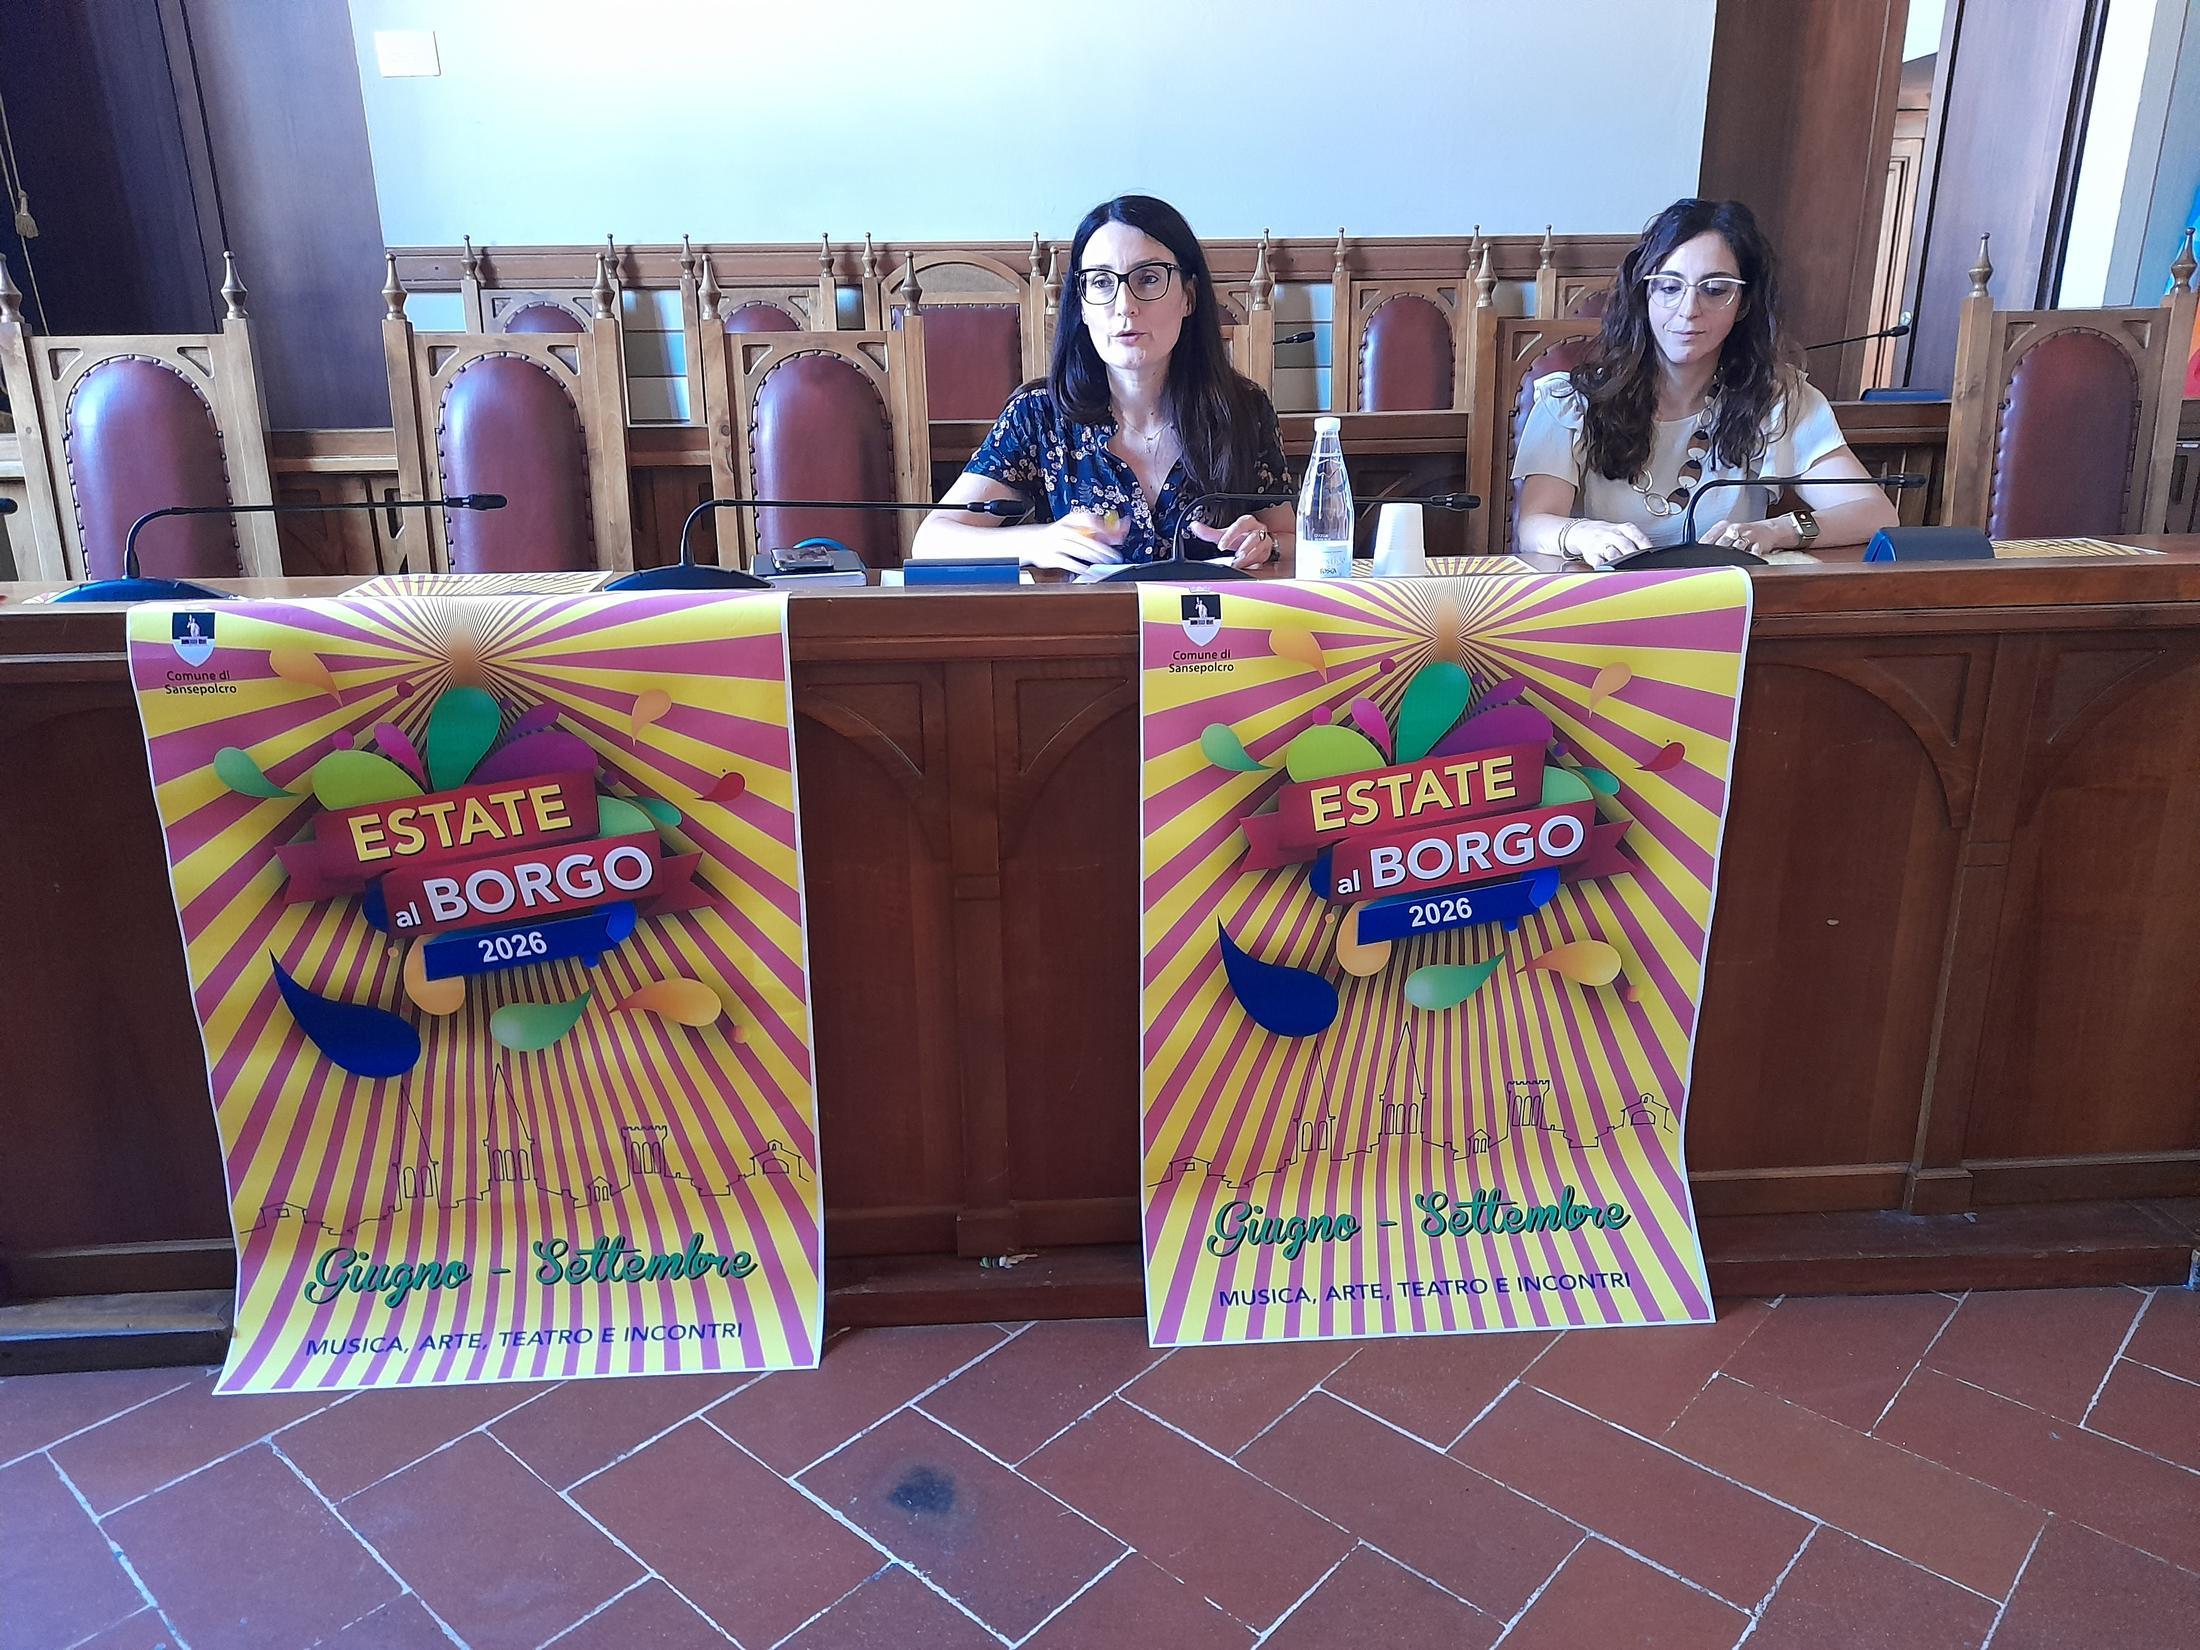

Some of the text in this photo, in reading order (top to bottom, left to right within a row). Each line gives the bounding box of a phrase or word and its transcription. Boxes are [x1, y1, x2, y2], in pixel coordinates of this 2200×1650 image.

[1168, 662, 1234, 674] Sansepolcro
[1173, 649, 1231, 660] Comune di
[164, 683, 237, 696] Sansepolcro
[166, 670, 230, 681] Comune di
[1310, 754, 1517, 834] ESTATE
[346, 783, 574, 864] ESTATE
[1337, 813, 1586, 896] al BORGO
[395, 845, 655, 930] al BORGO
[1408, 896, 1474, 929] 2026
[477, 931, 549, 964] 2026
[1206, 1200, 1361, 1260] Giugno
[1414, 1184, 1633, 1239] Settembre
[304, 1246, 472, 1309] Giugno
[532, 1231, 759, 1286] Settembre
[1217, 1270, 1632, 1307] MUSICA, ARTE, TEATRO E INCONTRI
[305, 1321, 744, 1356] MUSICA, ARTE, TEATRO E INCONTRI
